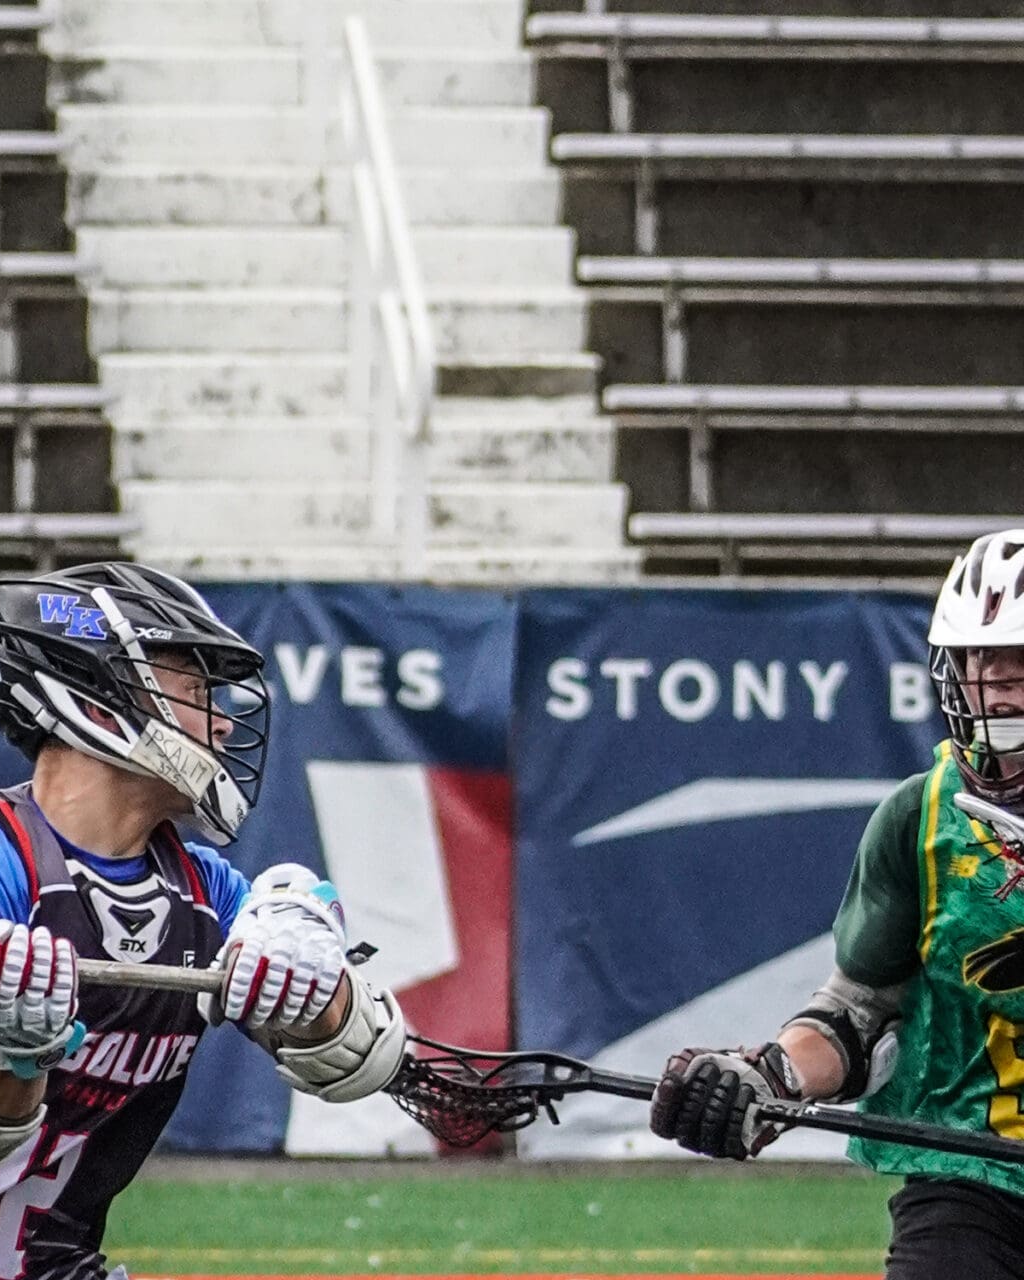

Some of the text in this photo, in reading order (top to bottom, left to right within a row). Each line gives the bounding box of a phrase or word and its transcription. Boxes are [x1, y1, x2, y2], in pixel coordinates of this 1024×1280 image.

[37, 593, 108, 641] WK
[546, 657, 932, 723] STONY B
[144, 728, 209, 785] PSALM
[119, 938, 146, 953] STX
[56, 1031, 199, 1086] SOLUTE
